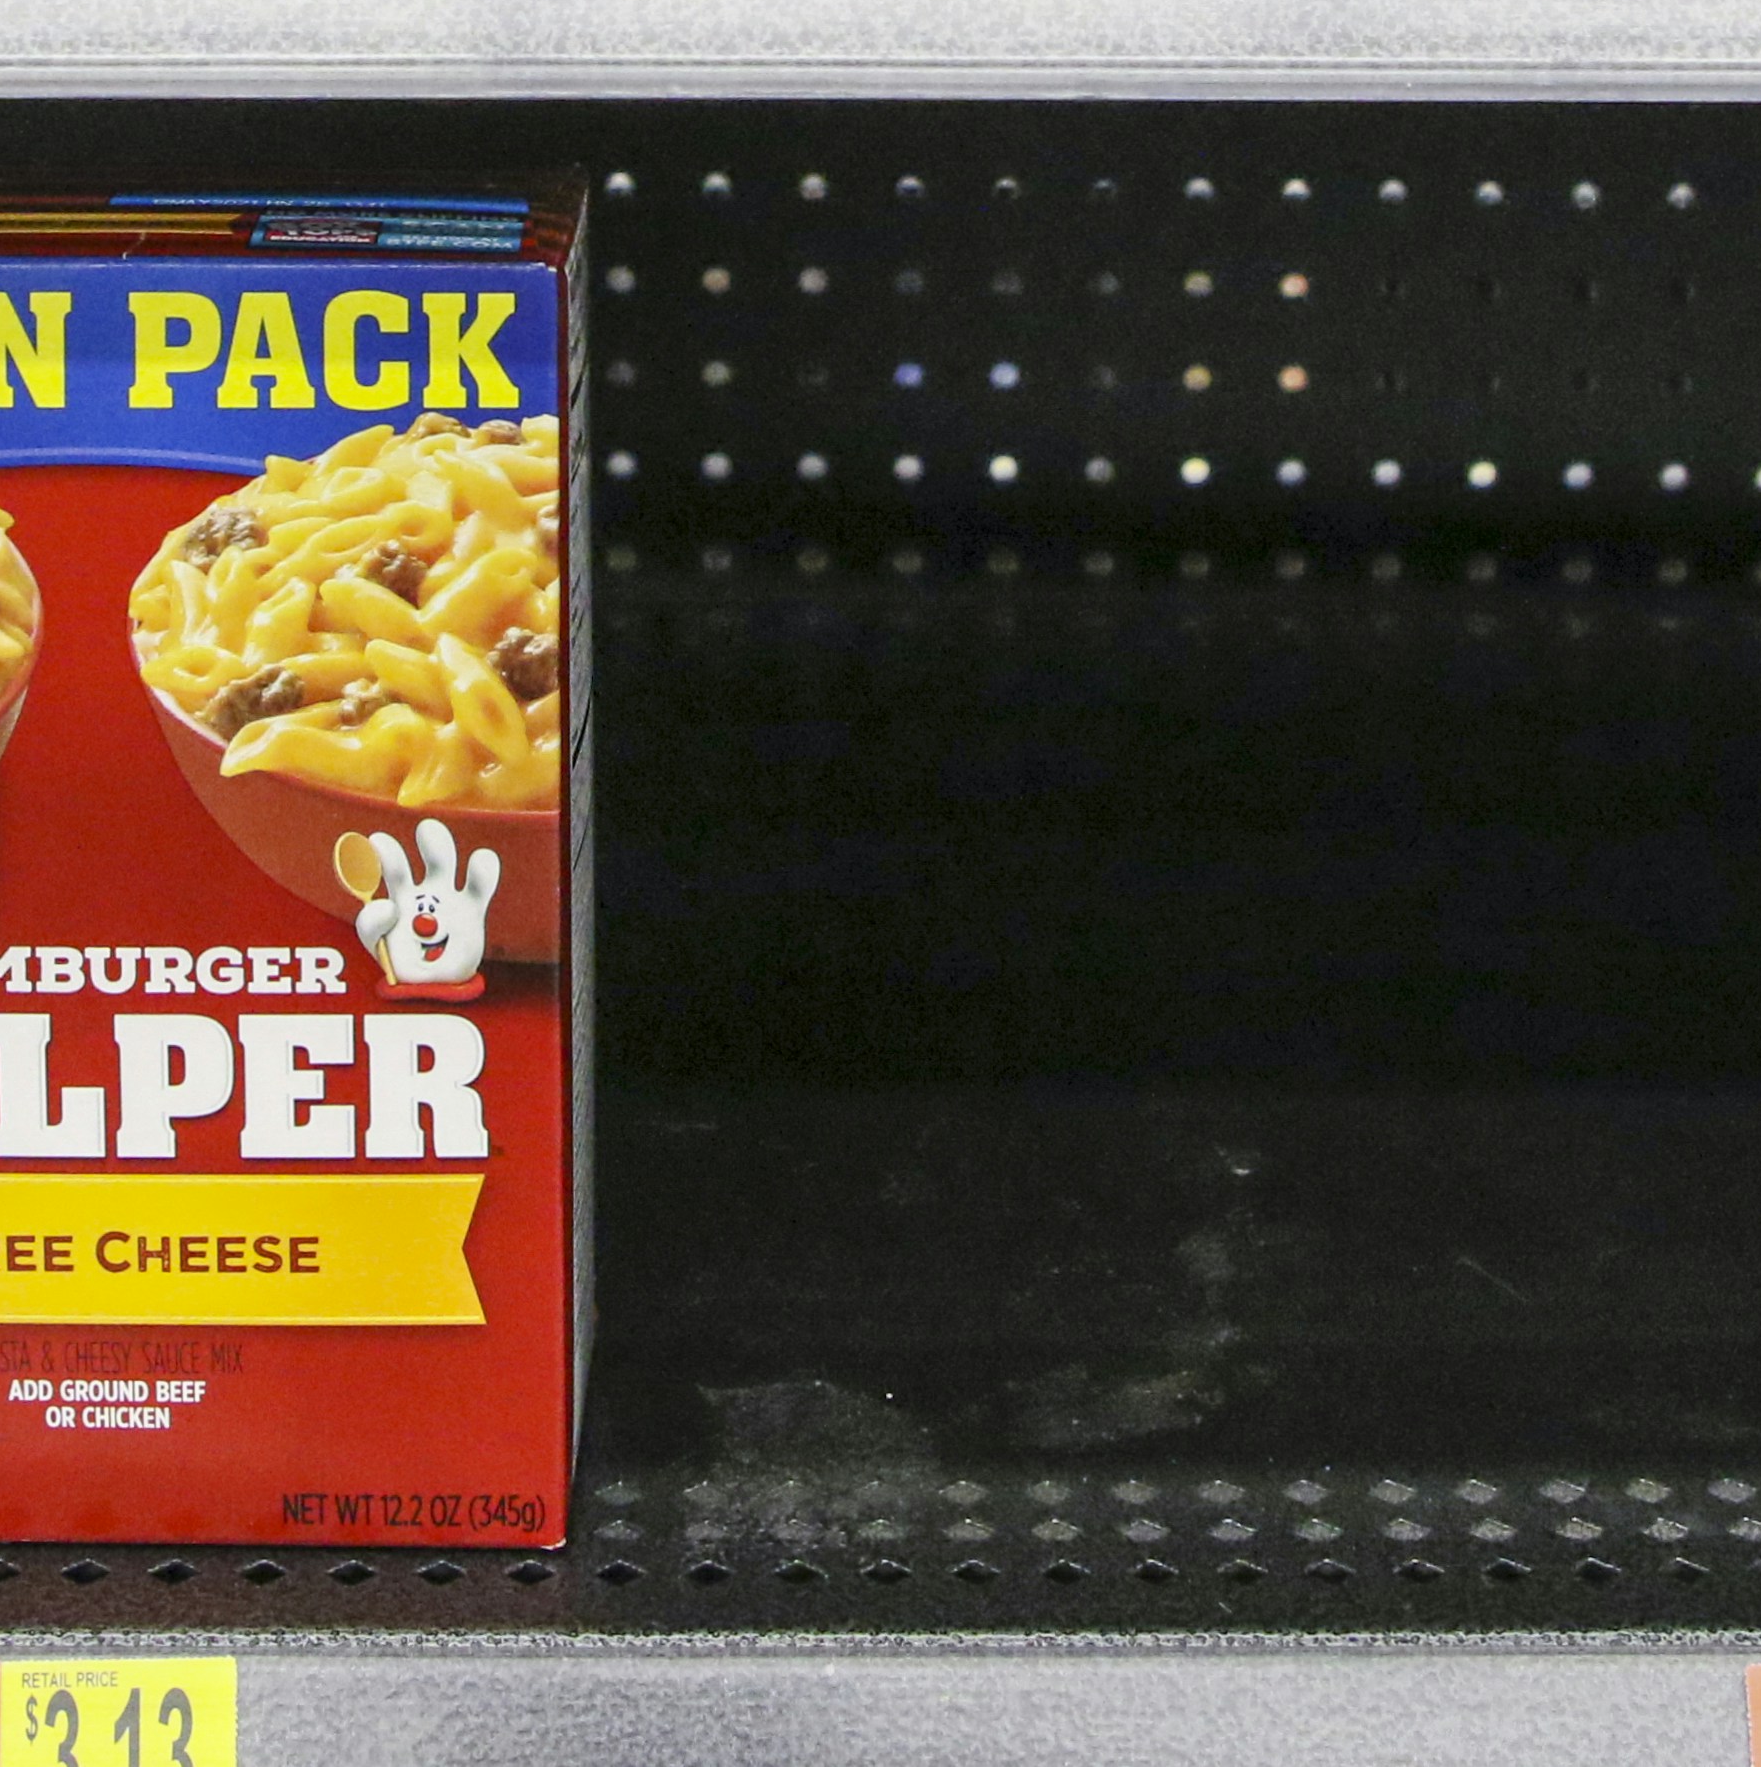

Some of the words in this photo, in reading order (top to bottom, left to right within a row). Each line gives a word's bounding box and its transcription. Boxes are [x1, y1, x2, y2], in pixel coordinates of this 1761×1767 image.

[128, 289, 520, 411] PACK
[96, 1230, 321, 1275] CHEESE
[40, 1340, 55, 1373] &
[64, 1341, 132, 1374] CHEESY
[143, 1341, 200, 1374] SAUCE
[210, 1342, 244, 1374] MIX
[8, 1379, 53, 1401] ADD
[59, 1380, 149, 1402] GROUND
[155, 1381, 206, 1403] BEEF
[45, 1406, 76, 1428] OR
[82, 1406, 171, 1429] CHICKEN
[282, 1493, 328, 1525] NET
[335, 1494, 375, 1525] WT
[380, 1494, 423, 1526] 12.2
[430, 1495, 461, 1526] OZ
[468, 1494, 546, 1532] (345g)
[22, 1672, 71, 1688] RETAIL
[76, 1671, 119, 1687] PRICE
